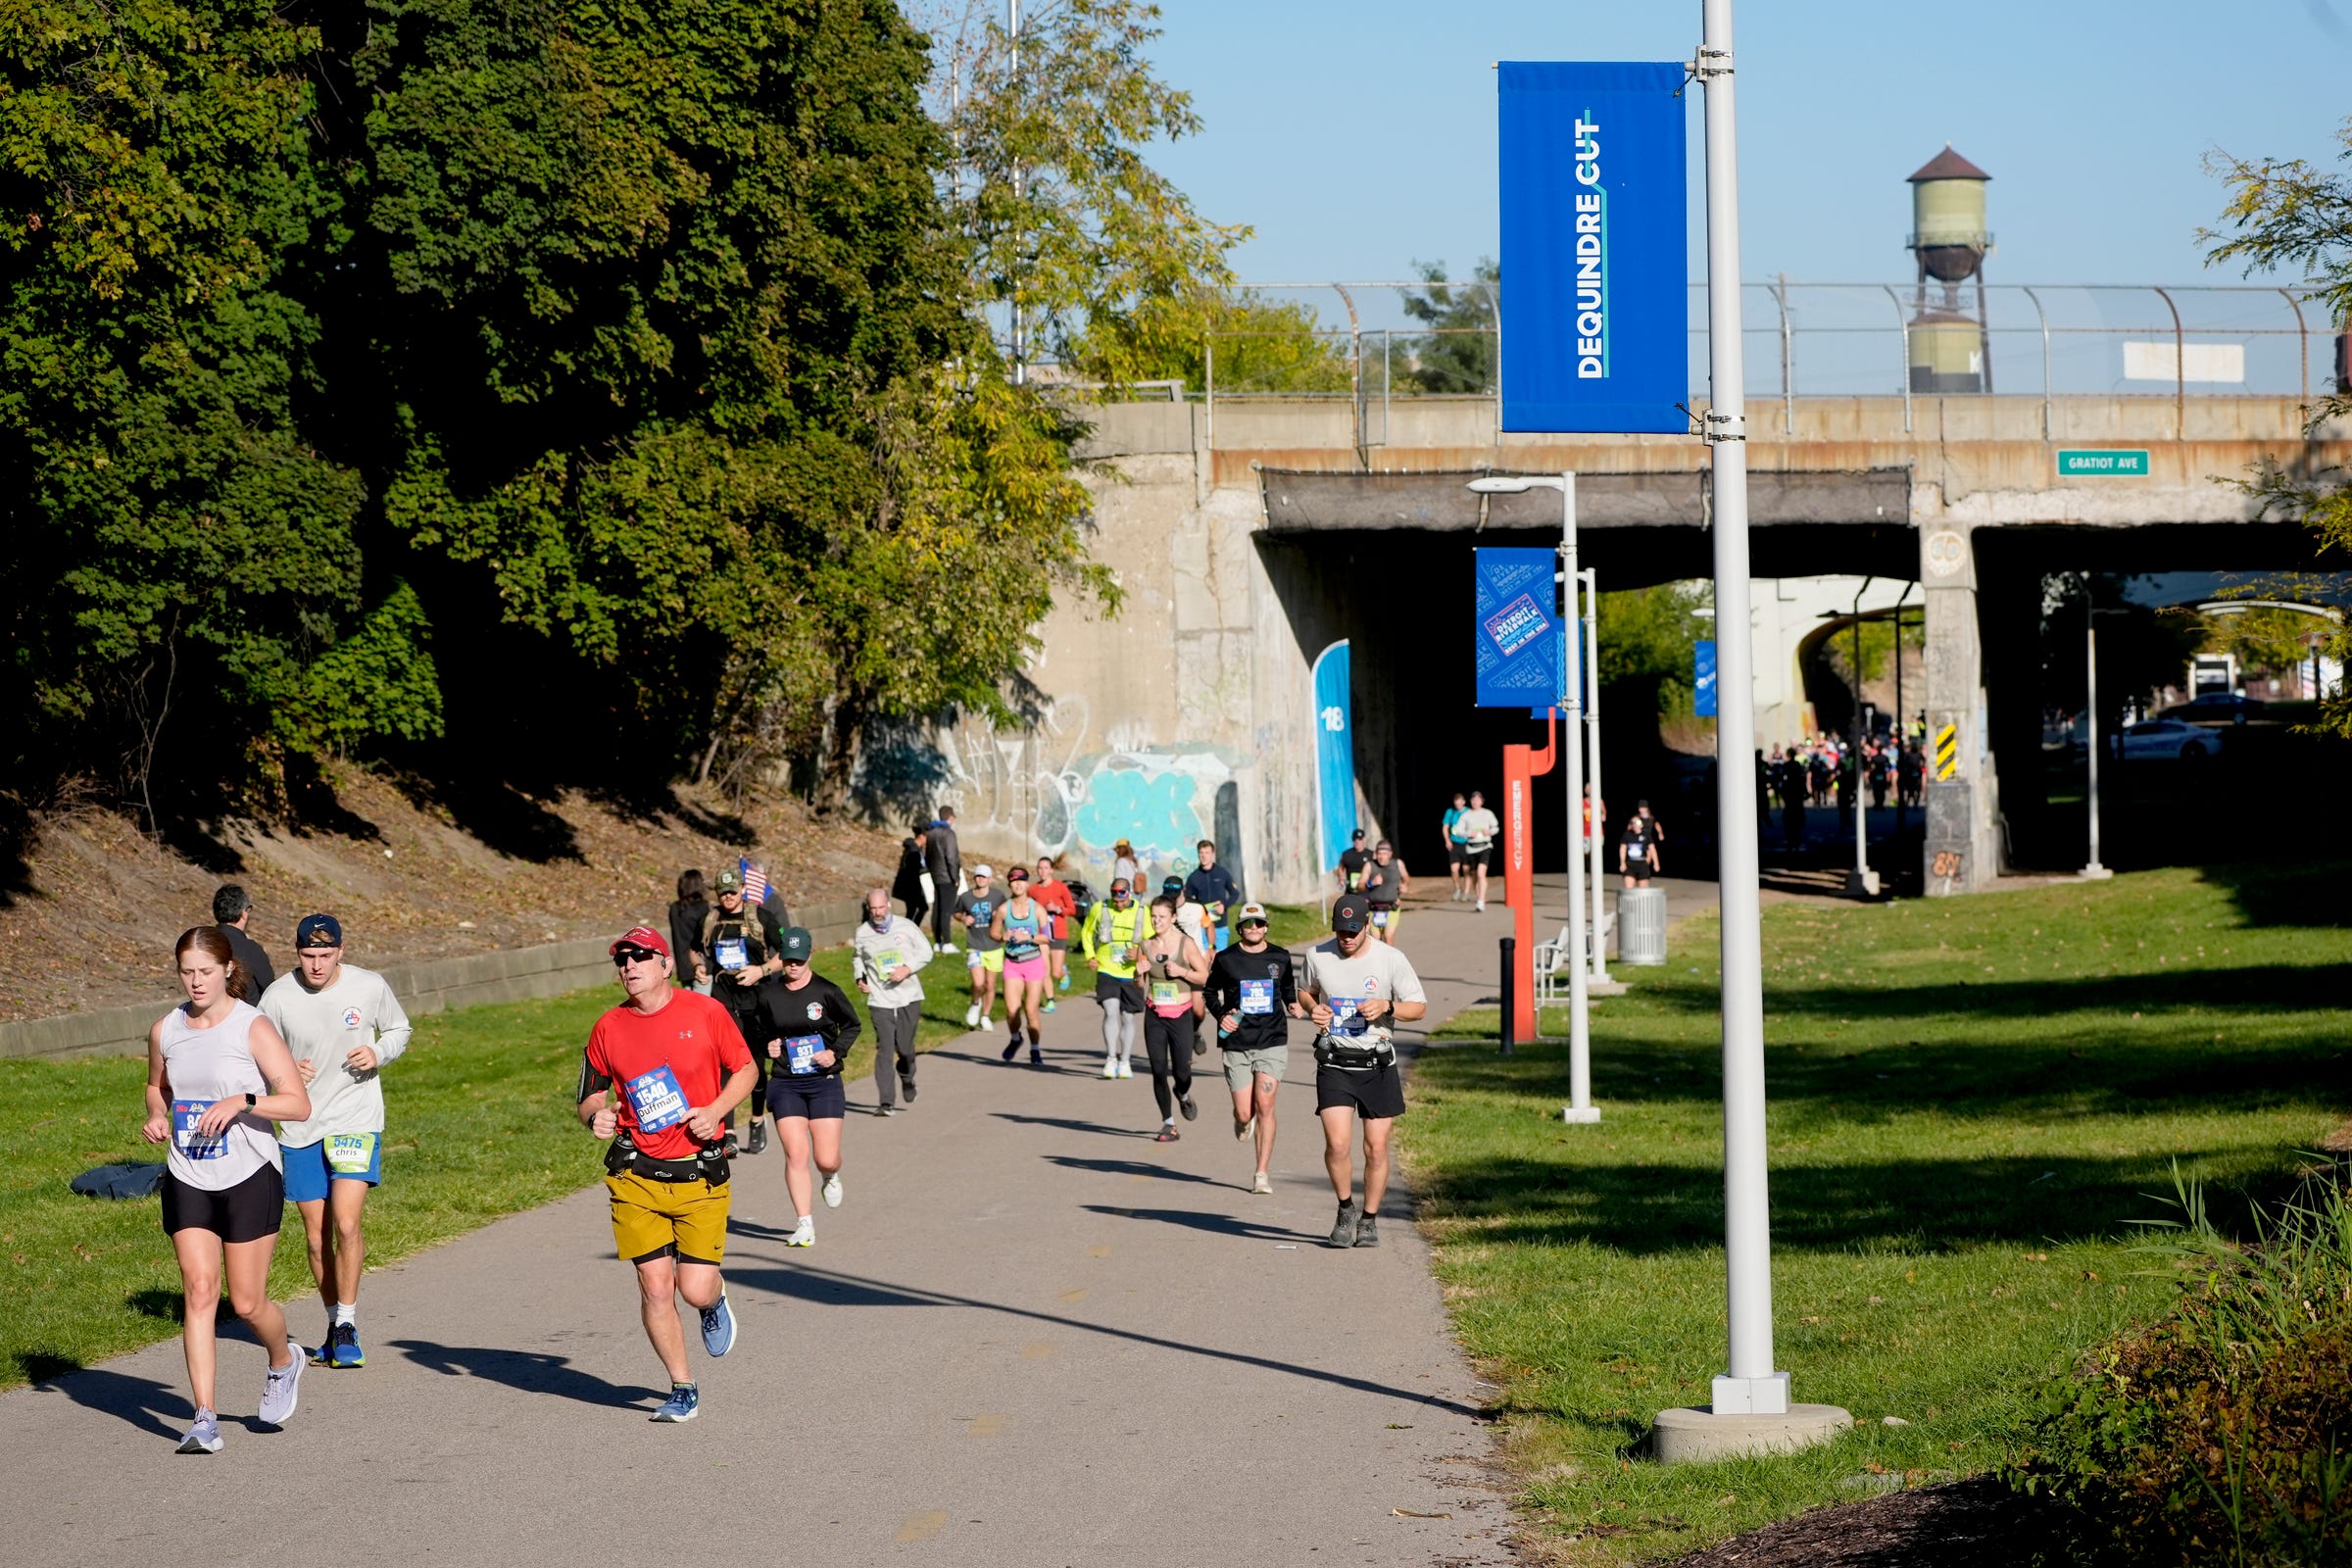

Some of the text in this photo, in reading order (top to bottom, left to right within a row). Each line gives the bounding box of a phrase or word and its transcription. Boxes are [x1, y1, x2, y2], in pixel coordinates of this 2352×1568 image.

[1575, 119, 1602, 378] DEQUINDRE CUT
[2069, 457, 2138, 469] GRATIOT AVE
[1494, 609, 1539, 642] RIVERWALK
[1496, 607, 1529, 633] DETROIT
[1535, 622, 1546, 632] USA
[1320, 706, 1345, 731] 18
[1512, 780, 1523, 871] EMERGENCY
[1341, 1005, 1357, 1018] 867
[636, 1081, 668, 1106] 1540
[638, 1094, 678, 1117] Duffman
[334, 1137, 363, 1149] 5475
[335, 1148, 358, 1156] chris
